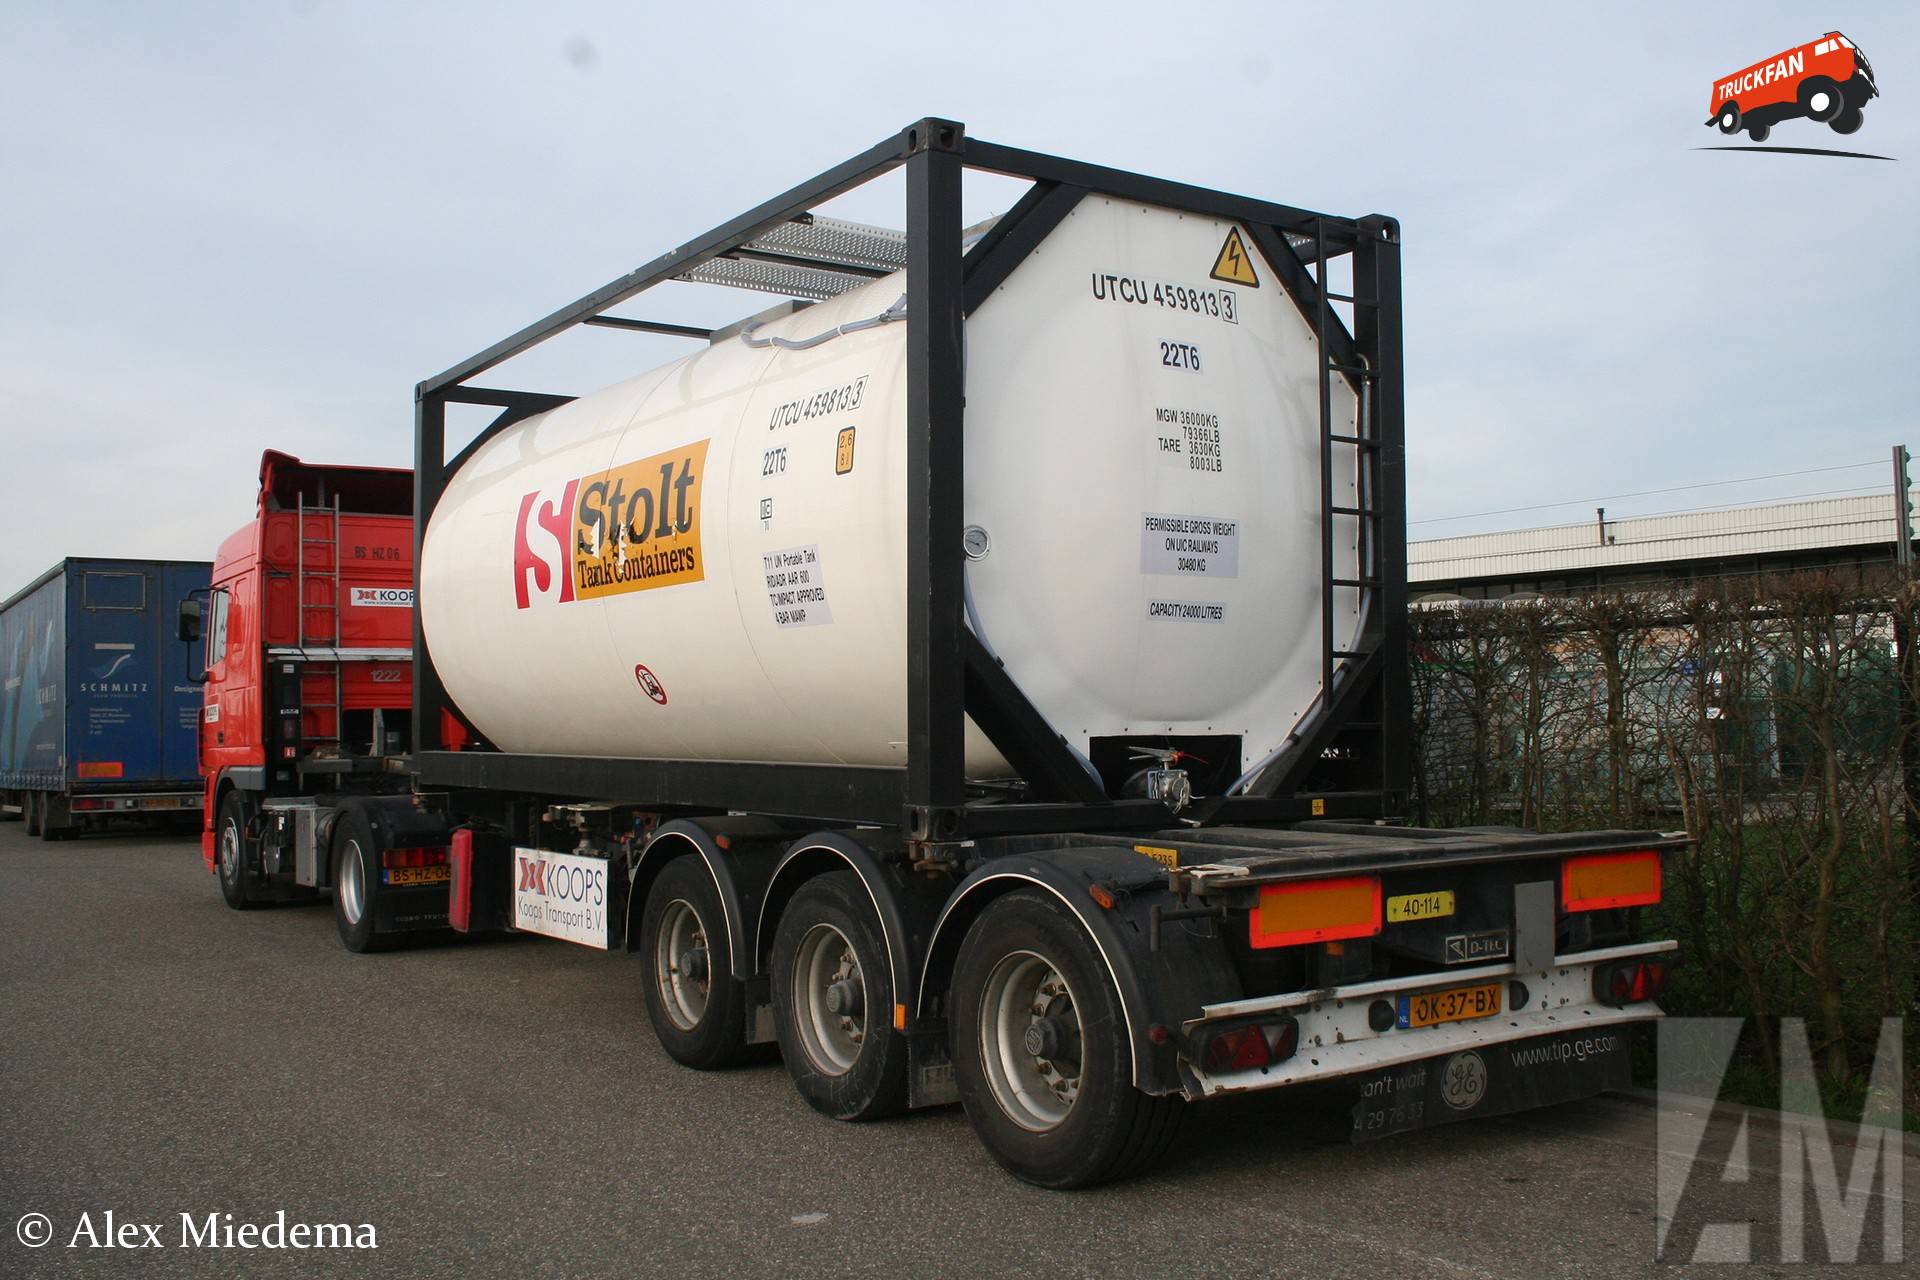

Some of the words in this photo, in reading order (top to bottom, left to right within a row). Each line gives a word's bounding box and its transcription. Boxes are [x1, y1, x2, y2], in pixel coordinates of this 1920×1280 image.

[1092, 273, 1148, 304] UTCU
[1153, 283, 1219, 317] 459813
[1160, 341, 1200, 371] 22T6
[769, 399, 805, 431] UTCU
[804, 385, 852, 421] 459813
[1156, 408, 1178, 423] MGW
[1180, 411, 1219, 428] 36000KG
[1182, 426, 1220, 443] 79366LB
[1158, 437, 1181, 453] TARE
[1189, 441, 1221, 457] 3630KG
[763, 447, 787, 476] 22T6
[1190, 456, 1222, 472] 8003LB
[577, 458, 695, 555] Stolt
[1145, 517, 1189, 533] PERMISSIBLE
[1189, 520, 1212, 535] GROSS
[1212, 522, 1236, 537] WEIGHT
[372, 547, 385, 560] HZ
[386, 547, 400, 560] 06
[1165, 537, 1176, 551] ON
[1176, 538, 1188, 552] UIC
[1188, 539, 1219, 554] RAILWAYS
[577, 554, 614, 589] Tank
[612, 545, 695, 584] Containers
[763, 556, 774, 569] T11
[774, 554, 783, 568] UN
[783, 551, 803, 567] Portable
[803, 548, 816, 564] Tank
[1177, 557, 1197, 571] 30480
[1197, 558, 1206, 572] KG
[788, 571, 799, 585] AAR
[380, 590, 413, 601] KOOP
[796, 587, 825, 604] APPROVED
[779, 610, 791, 624] BAR
[1150, 602, 1183, 618] CAPACITY
[1182, 605, 1201, 618] 24000
[1201, 606, 1223, 619] LITRES
[370, 670, 401, 682] 1222
[81, 683, 148, 692] SCHMITZ
[547, 863, 604, 906] KOOPS
[518, 895, 543, 927] Koops
[545, 901, 584, 933] Transport
[1403, 897, 1440, 916] 40-114
[1471, 938, 1503, 954] D-TEC
[1399, 1015, 1409, 1024] NL
[1416, 988, 1497, 1022] OK-37-BX
[1395, 1068, 1427, 1091] wait
